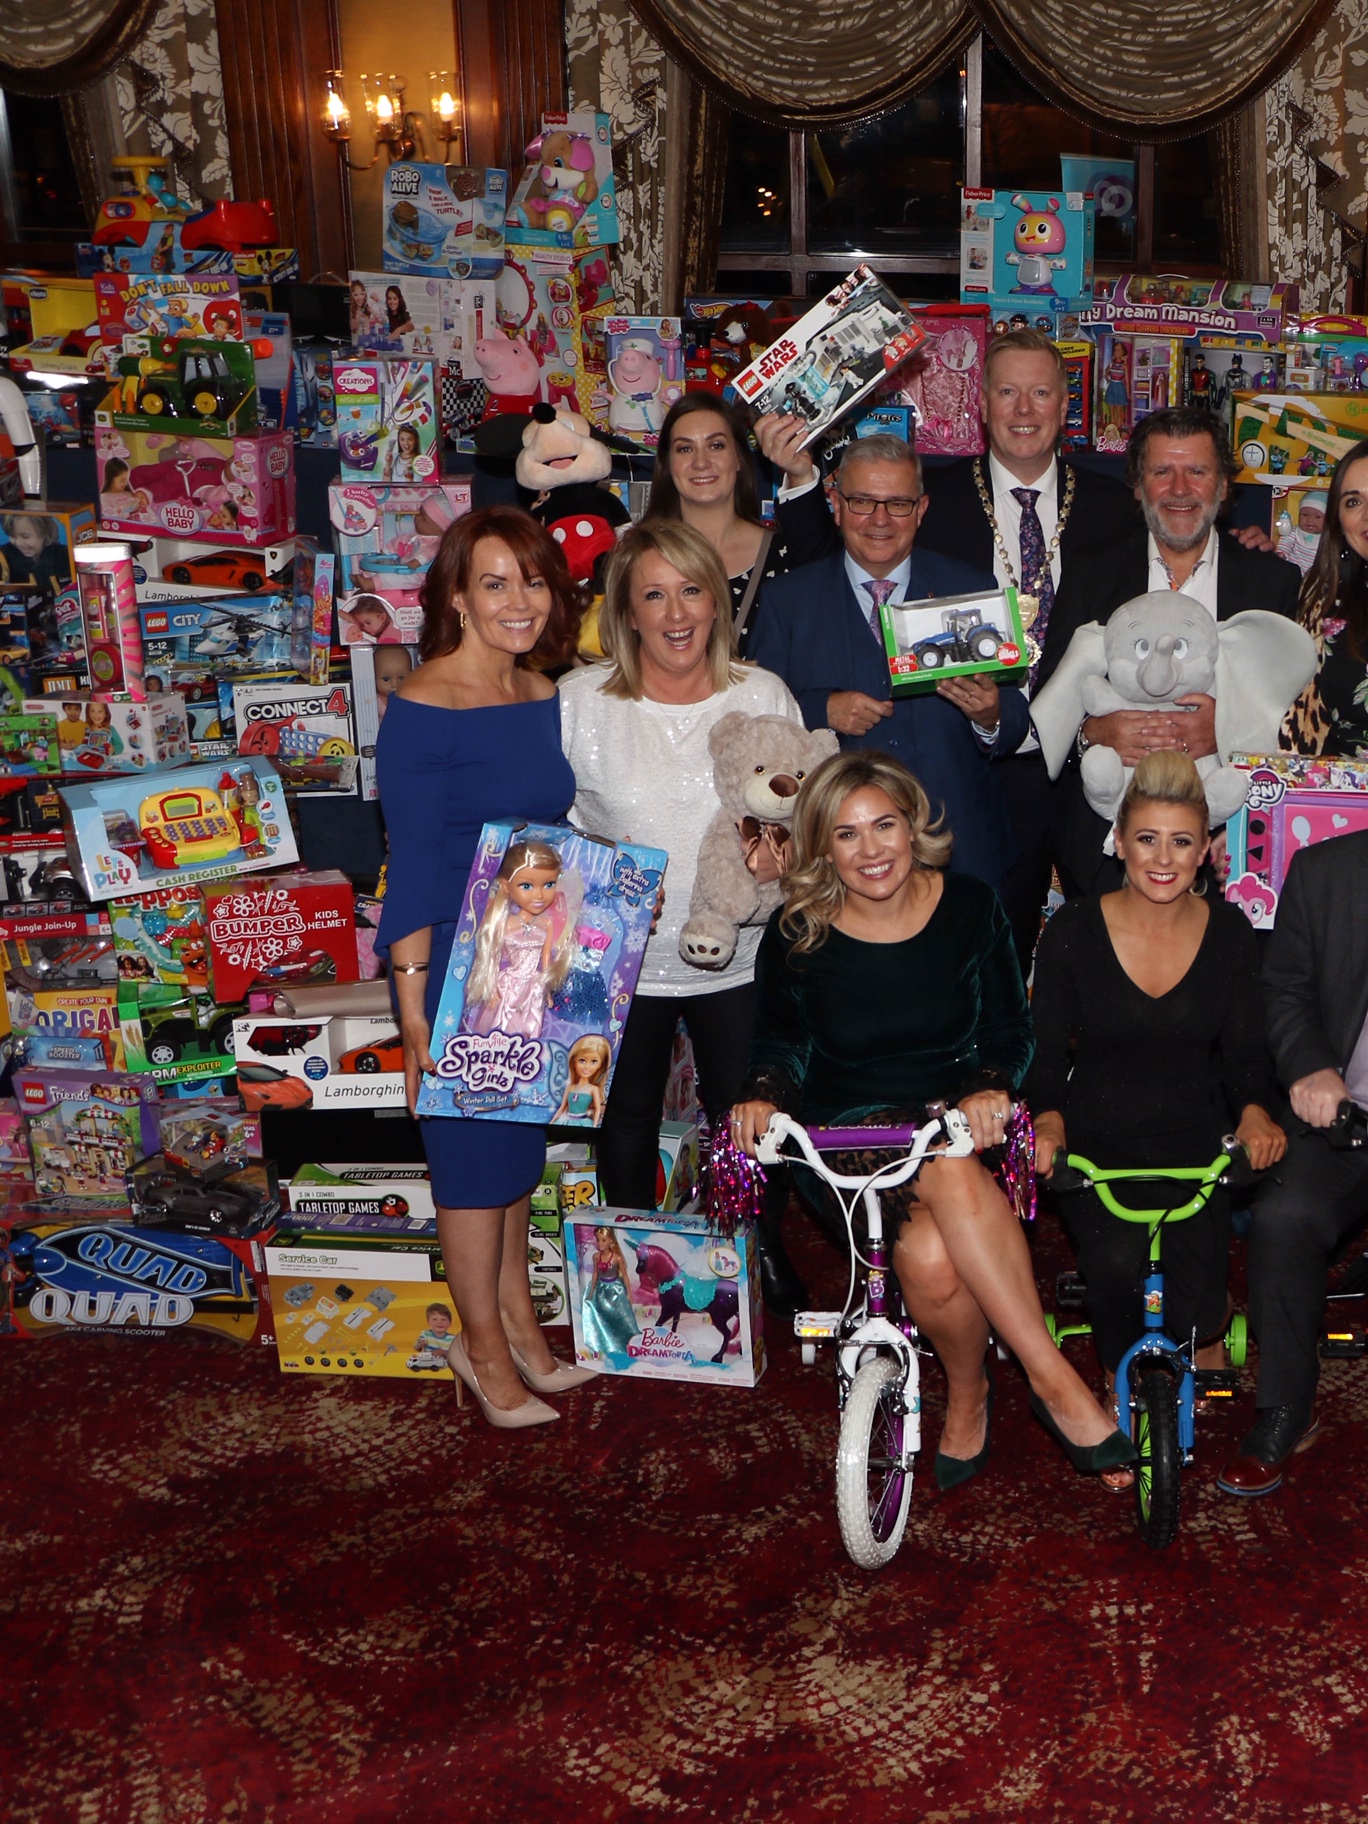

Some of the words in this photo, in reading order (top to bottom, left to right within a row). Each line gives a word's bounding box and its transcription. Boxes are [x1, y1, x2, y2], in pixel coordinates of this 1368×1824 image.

[390, 170, 420, 184] ROBO
[390, 182, 419, 195] ALIVE
[119, 280, 157, 302] DON'T
[160, 277, 189, 296] FALL
[193, 280, 230, 294] DOWN
[1106, 304, 1158, 319] Dream
[1162, 306, 1236, 329] Mansion
[758, 339, 795, 373] STAR
[761, 344, 799, 380] WARS
[1096, 436, 1127, 452] Barbie
[268, 450, 287, 462] HELLO
[270, 460, 285, 471] BABY
[165, 507, 195, 519] HELLO
[167, 518, 194, 530] BABY
[147, 618, 166, 627] LEGO
[148, 642, 167, 650] 5-12
[247, 700, 328, 719] CONNECT
[327, 690, 348, 716] 4
[202, 749, 230, 757] WARS
[156, 876, 186, 888] CASH
[188, 865, 237, 881] REGISTER
[315, 911, 339, 919] KIDS
[14, 920, 42, 933] Jungle
[44, 921, 77, 931] Join-Up
[308, 919, 347, 929] HELMET
[441, 1040, 536, 1077] Sparkle
[176, 1061, 221, 1073] EXPLOITER
[25, 1090, 43, 1098] LEGO
[50, 1087, 91, 1103] Friends
[325, 1084, 404, 1098] Lamborghin
[342, 1171, 389, 1179] TABLETOP
[391, 1171, 423, 1179] GAMES
[299, 1202, 345, 1213] TABLETOP
[348, 1202, 380, 1213] GAMES
[78, 1233, 207, 1293] QUAD
[279, 1254, 317, 1264] Service
[319, 1255, 338, 1265] Car
[29, 1289, 194, 1327] QUAD
[125, 1329, 166, 1337] SCOOTER
[642, 1328, 685, 1348] Barbie
